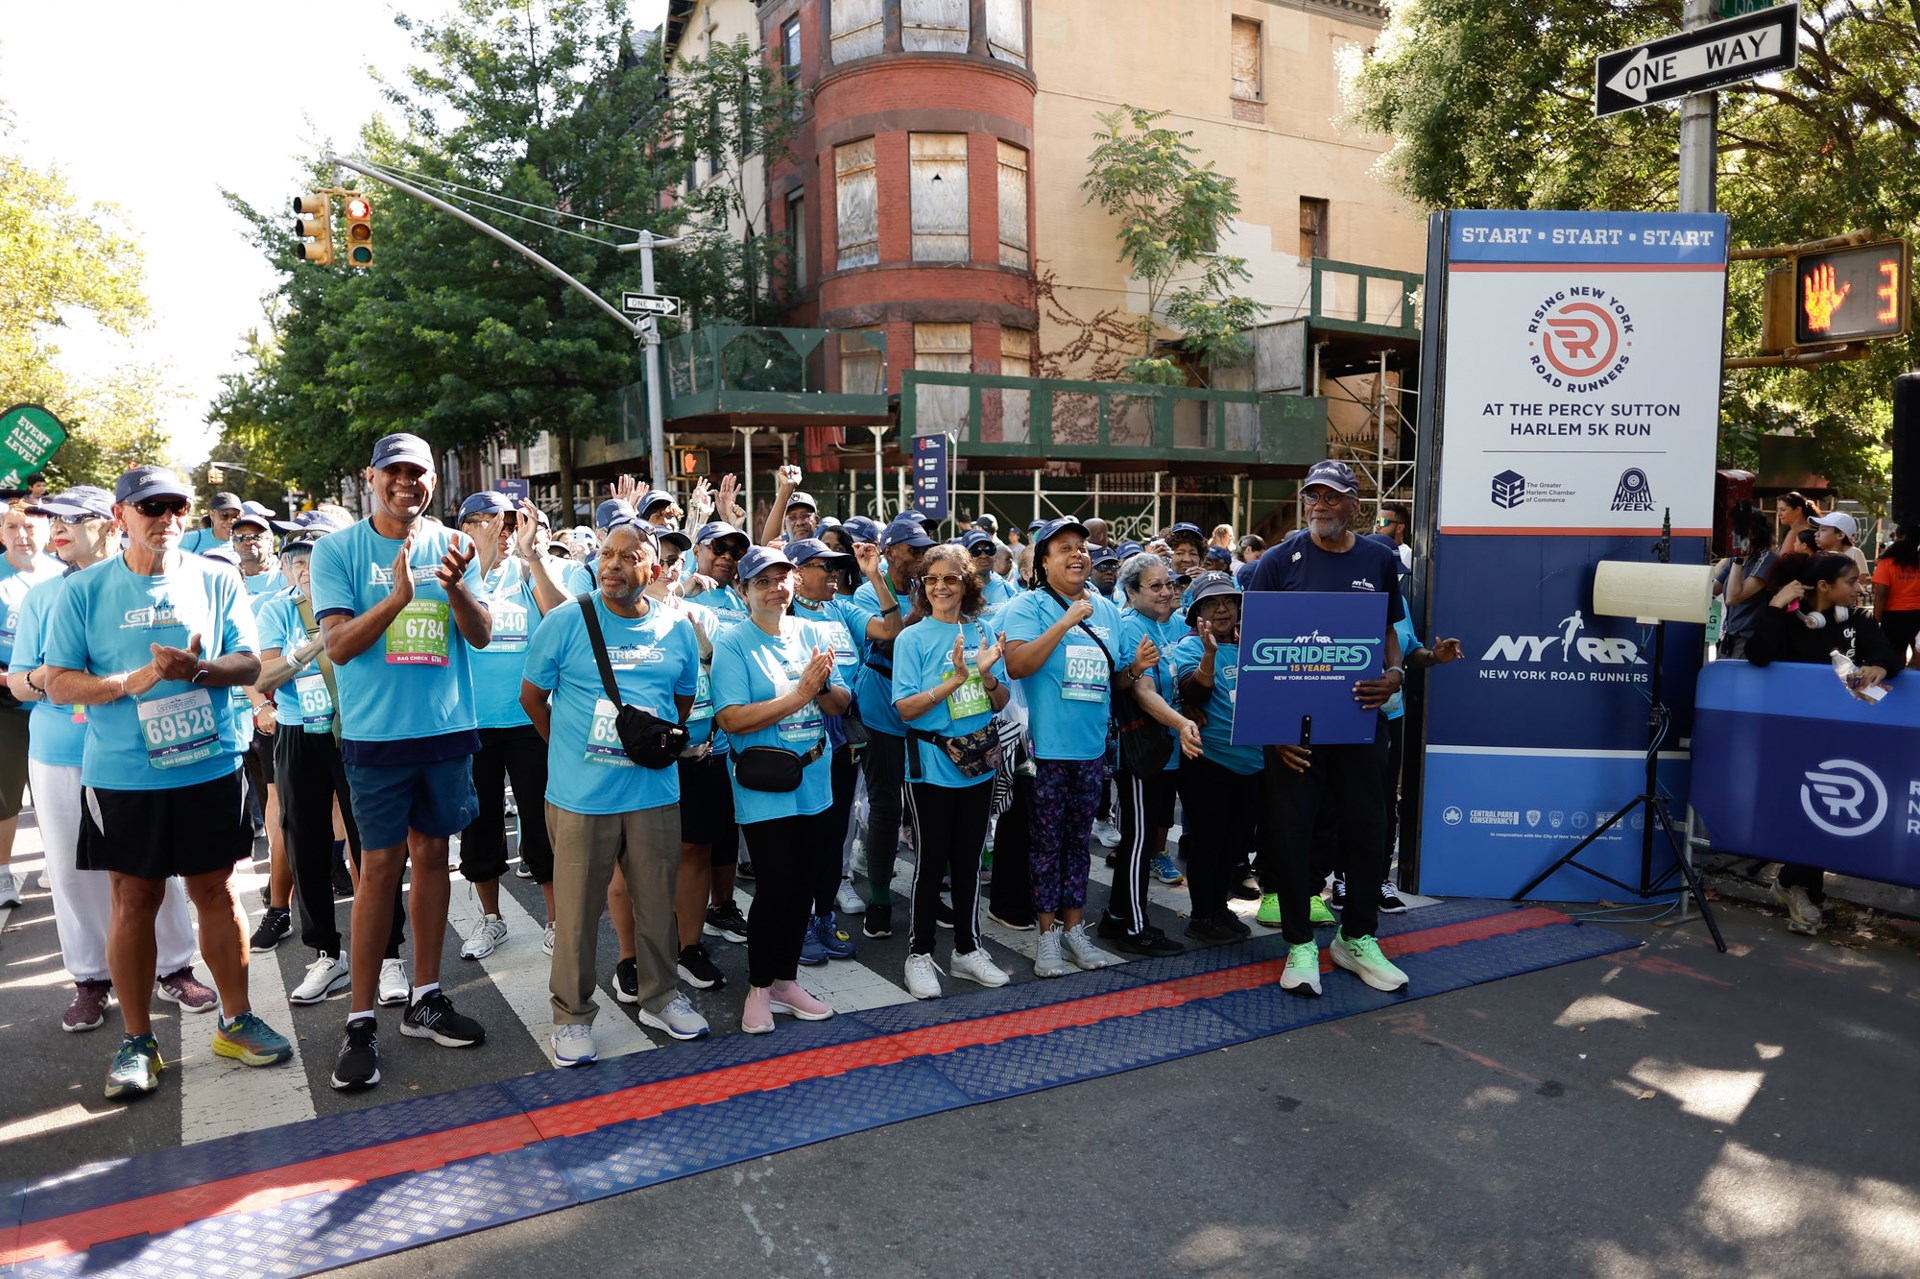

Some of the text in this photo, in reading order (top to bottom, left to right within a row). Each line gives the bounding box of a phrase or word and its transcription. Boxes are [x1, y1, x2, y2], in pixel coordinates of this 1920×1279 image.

[1625, 31, 1768, 90] ONE WAY
[1461, 227, 1714, 247] START START START
[1877, 260, 1899, 323] 3
[631, 300, 648, 308] ONE
[1528, 286, 1634, 334] RISING NEW YORK
[1529, 354, 1631, 393] ROAD RUNNERS
[1482, 403, 1681, 417] AT THE PERCY SUTTON
[17, 415, 53, 447] EVENT
[1510, 423, 1651, 437] HARLEM 5K RUN
[4, 436, 38, 466] LEVEL
[11, 427, 46, 456] ALERT
[1613, 485, 1653, 503] HARLEM
[1610, 502, 1655, 511] WEEK
[406, 618, 444, 641] 6784
[494, 613, 526, 632] 540
[1293, 634, 1333, 643] NYRR
[1261, 646, 1363, 663] STRIDERS
[1068, 659, 1108, 681] 69544
[1479, 669, 1648, 683] NEW YORK ROAD RUNNERS
[159, 700, 195, 713] STRIDERS
[147, 707, 214, 744] 69528
[1470, 810, 1496, 818] CENTRAL
